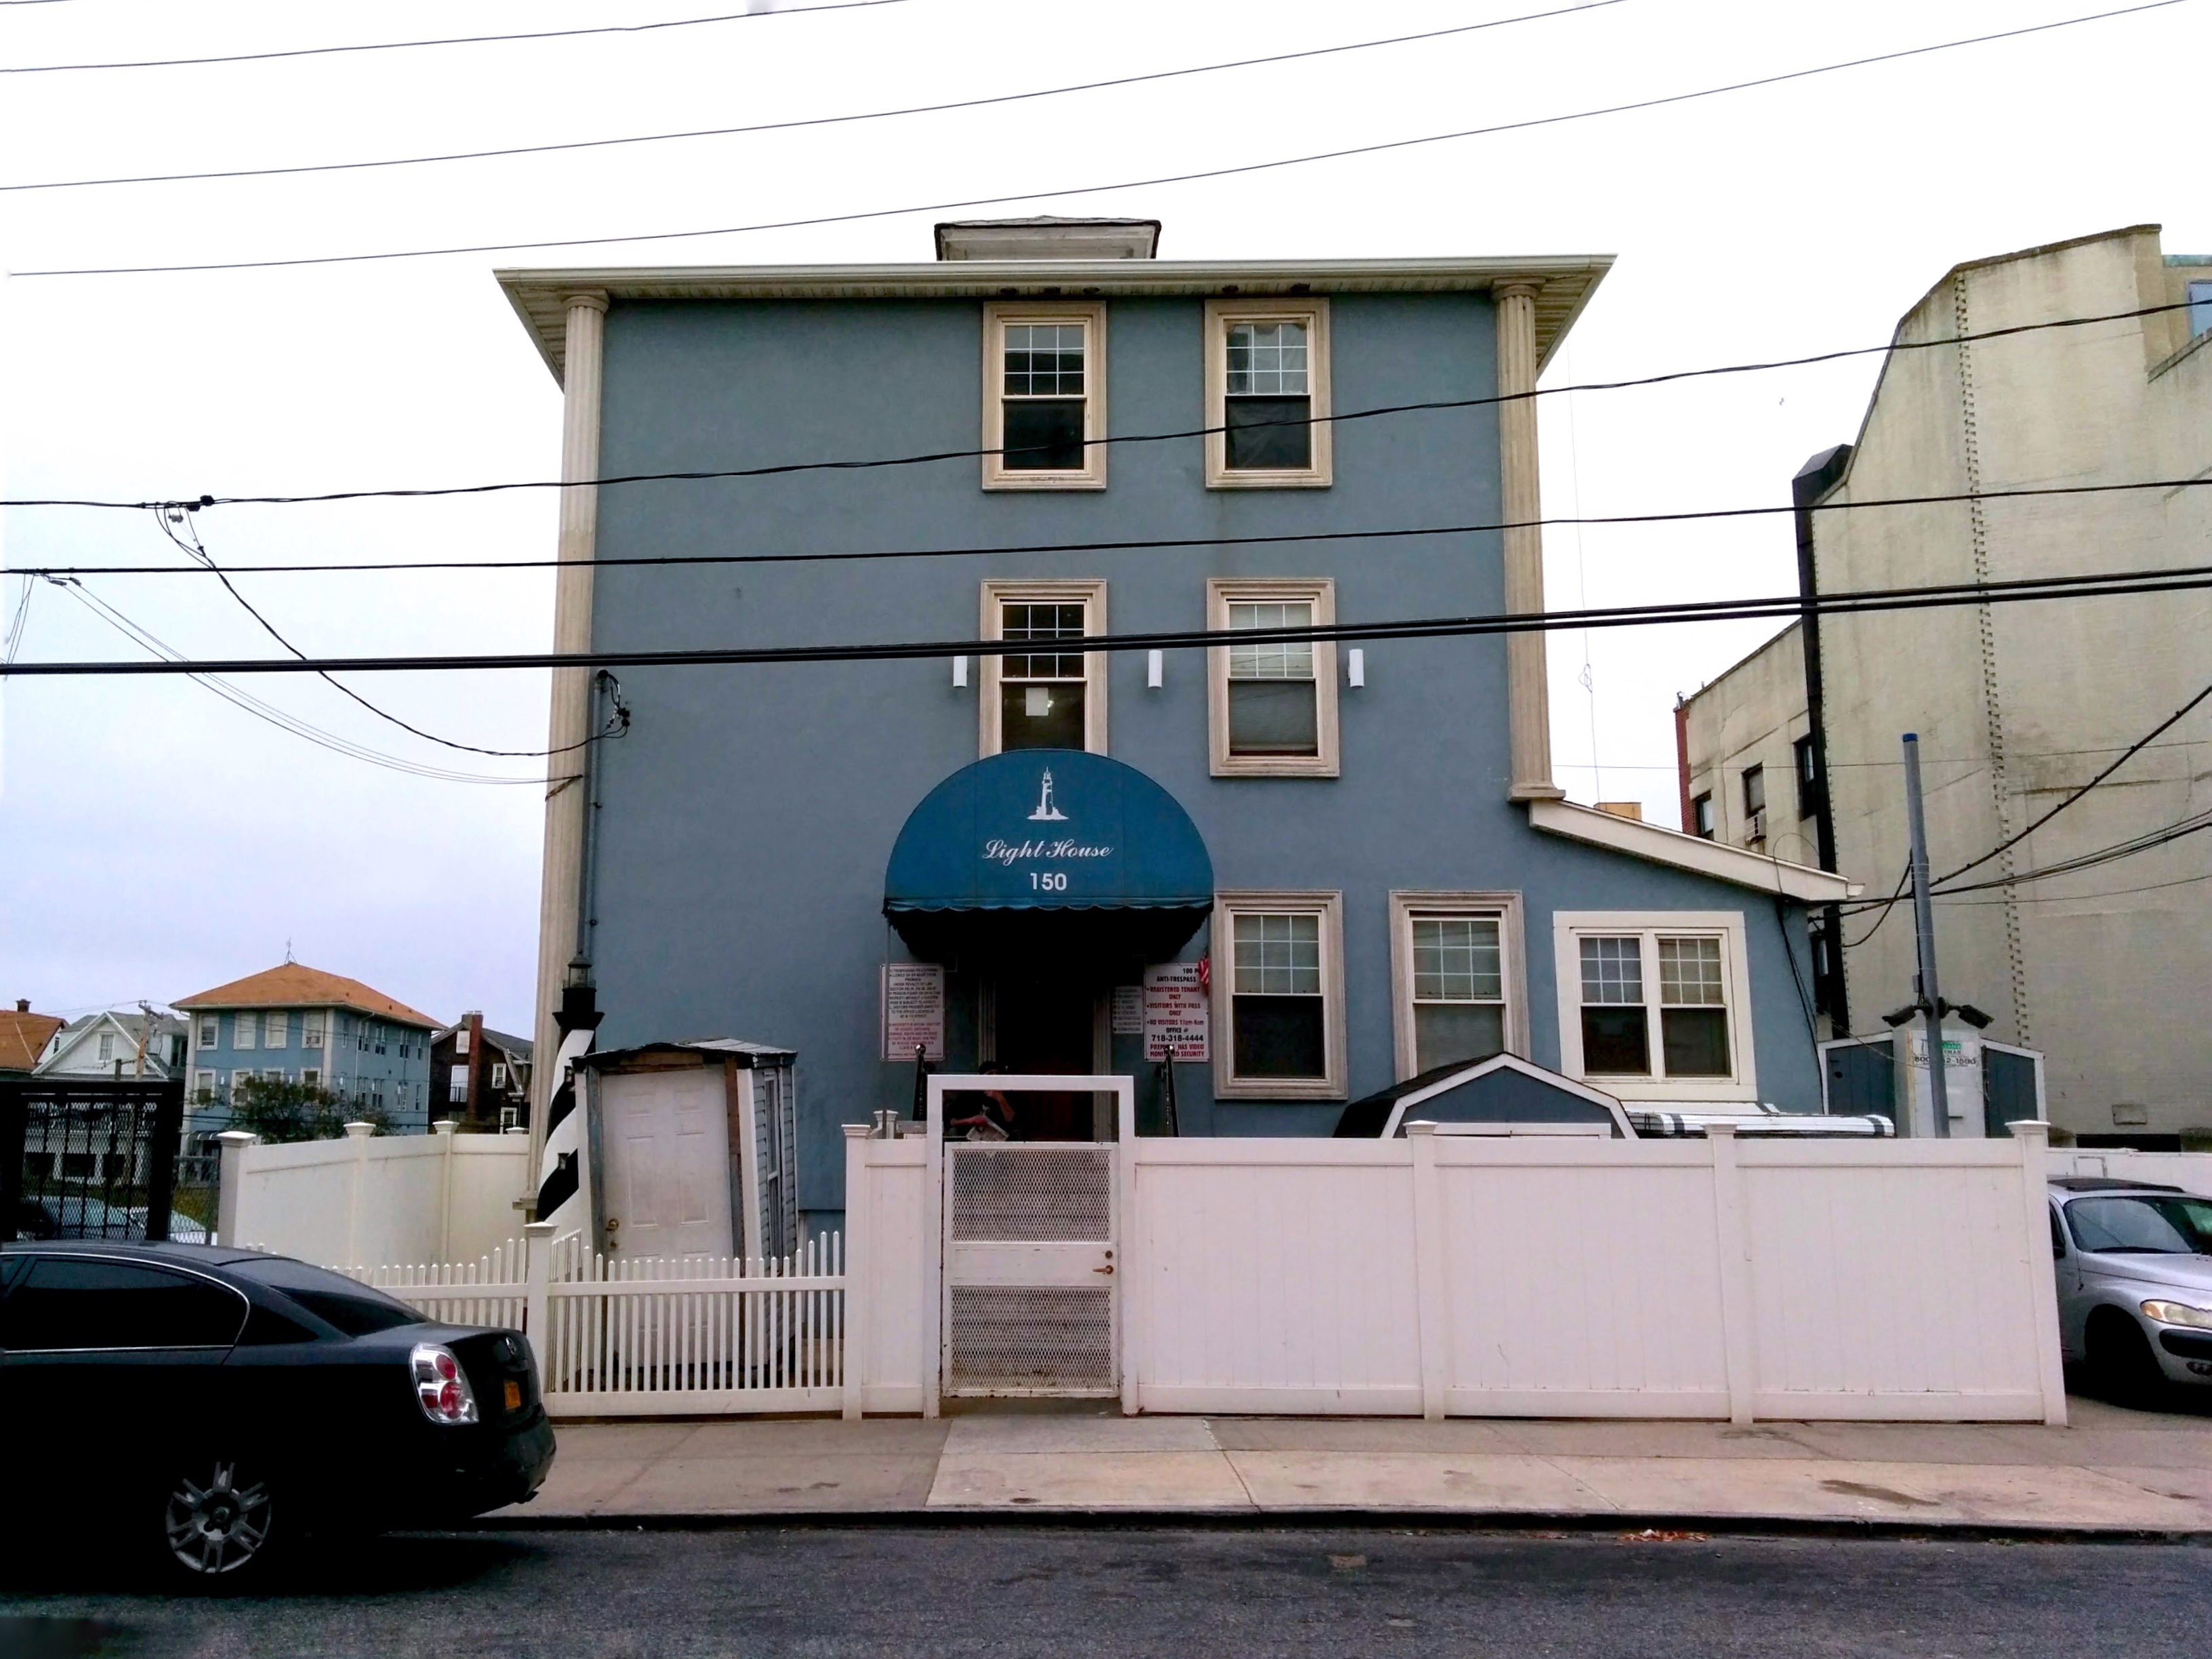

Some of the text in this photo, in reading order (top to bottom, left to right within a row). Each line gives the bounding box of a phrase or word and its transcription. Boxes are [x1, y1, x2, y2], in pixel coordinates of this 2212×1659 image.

[982, 839, 1114, 866] Light House
[1030, 873, 1067, 890] 150
